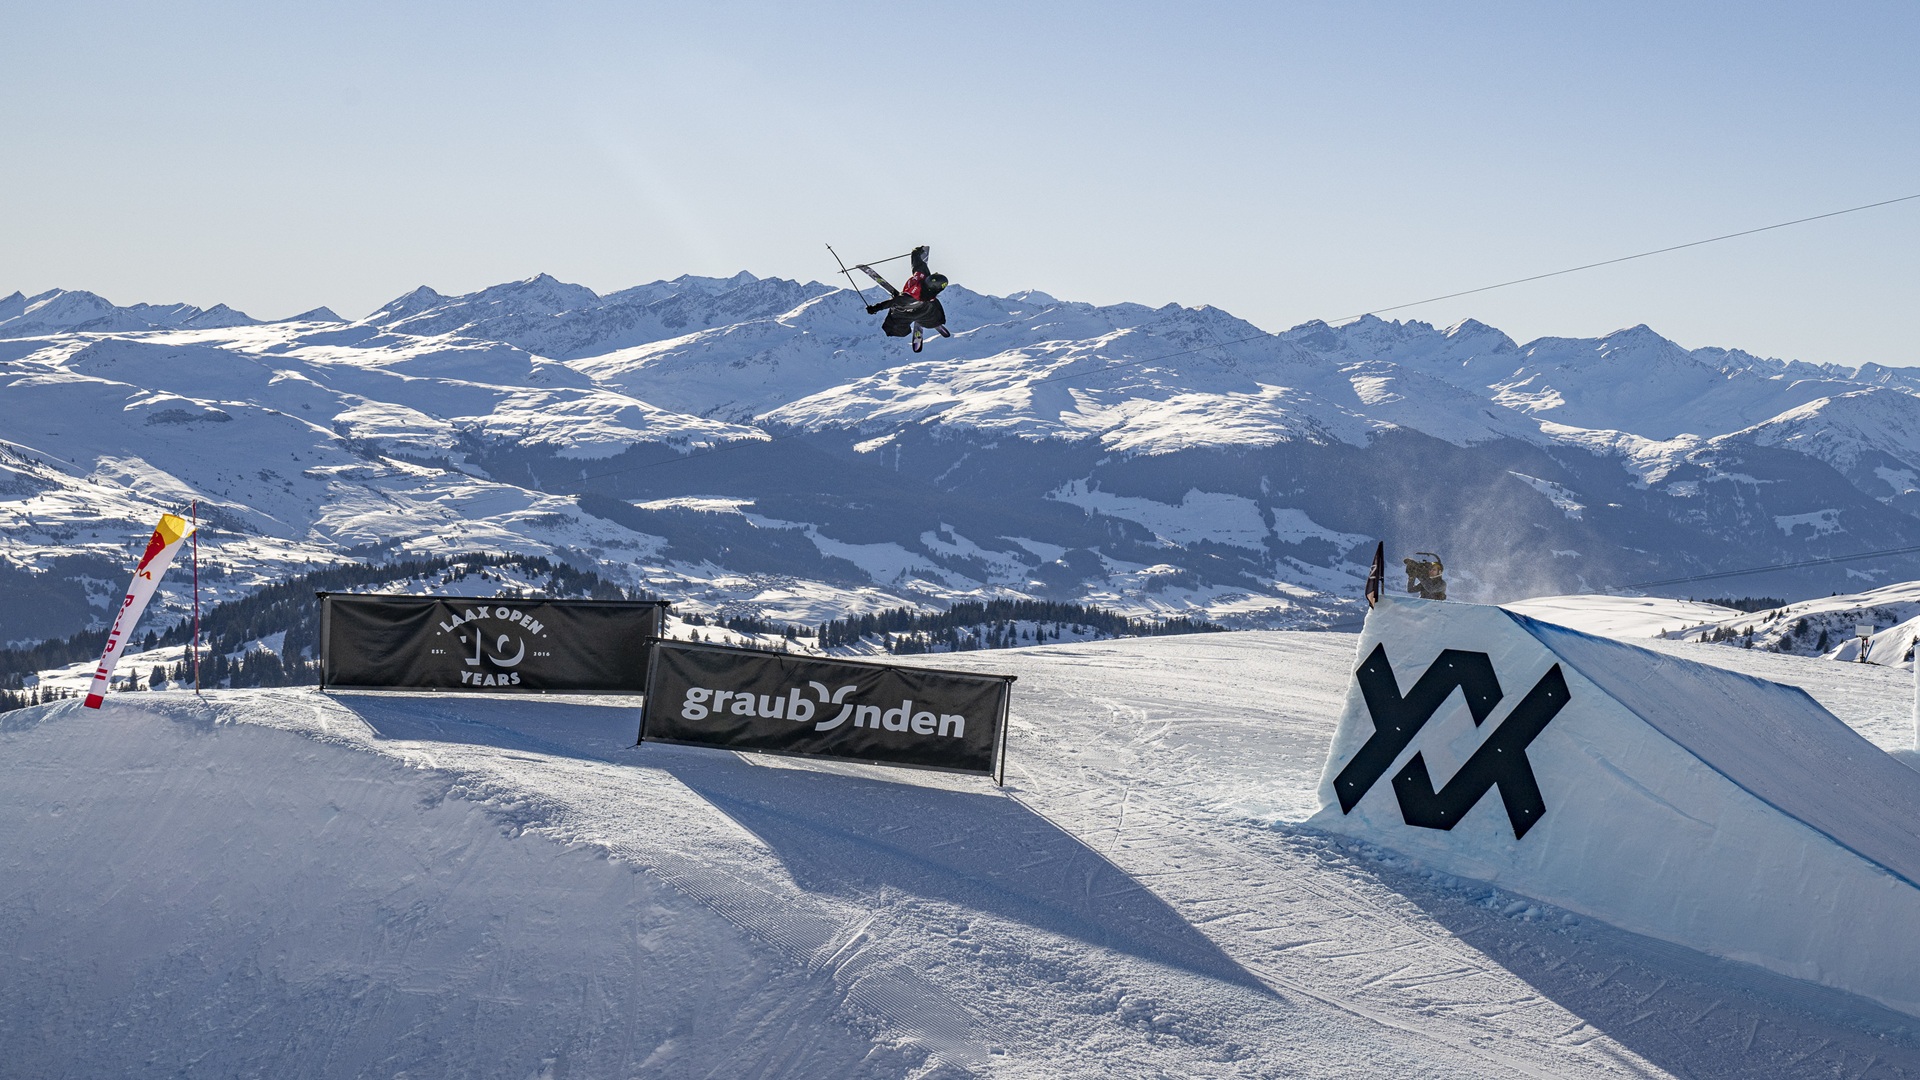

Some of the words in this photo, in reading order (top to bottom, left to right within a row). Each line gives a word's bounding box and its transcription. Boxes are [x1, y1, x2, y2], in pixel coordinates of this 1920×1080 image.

[440, 606, 490, 632] LAAX
[495, 606, 544, 635] OPEN
[460, 627, 525, 667] 10
[461, 670, 521, 686] YEARS
